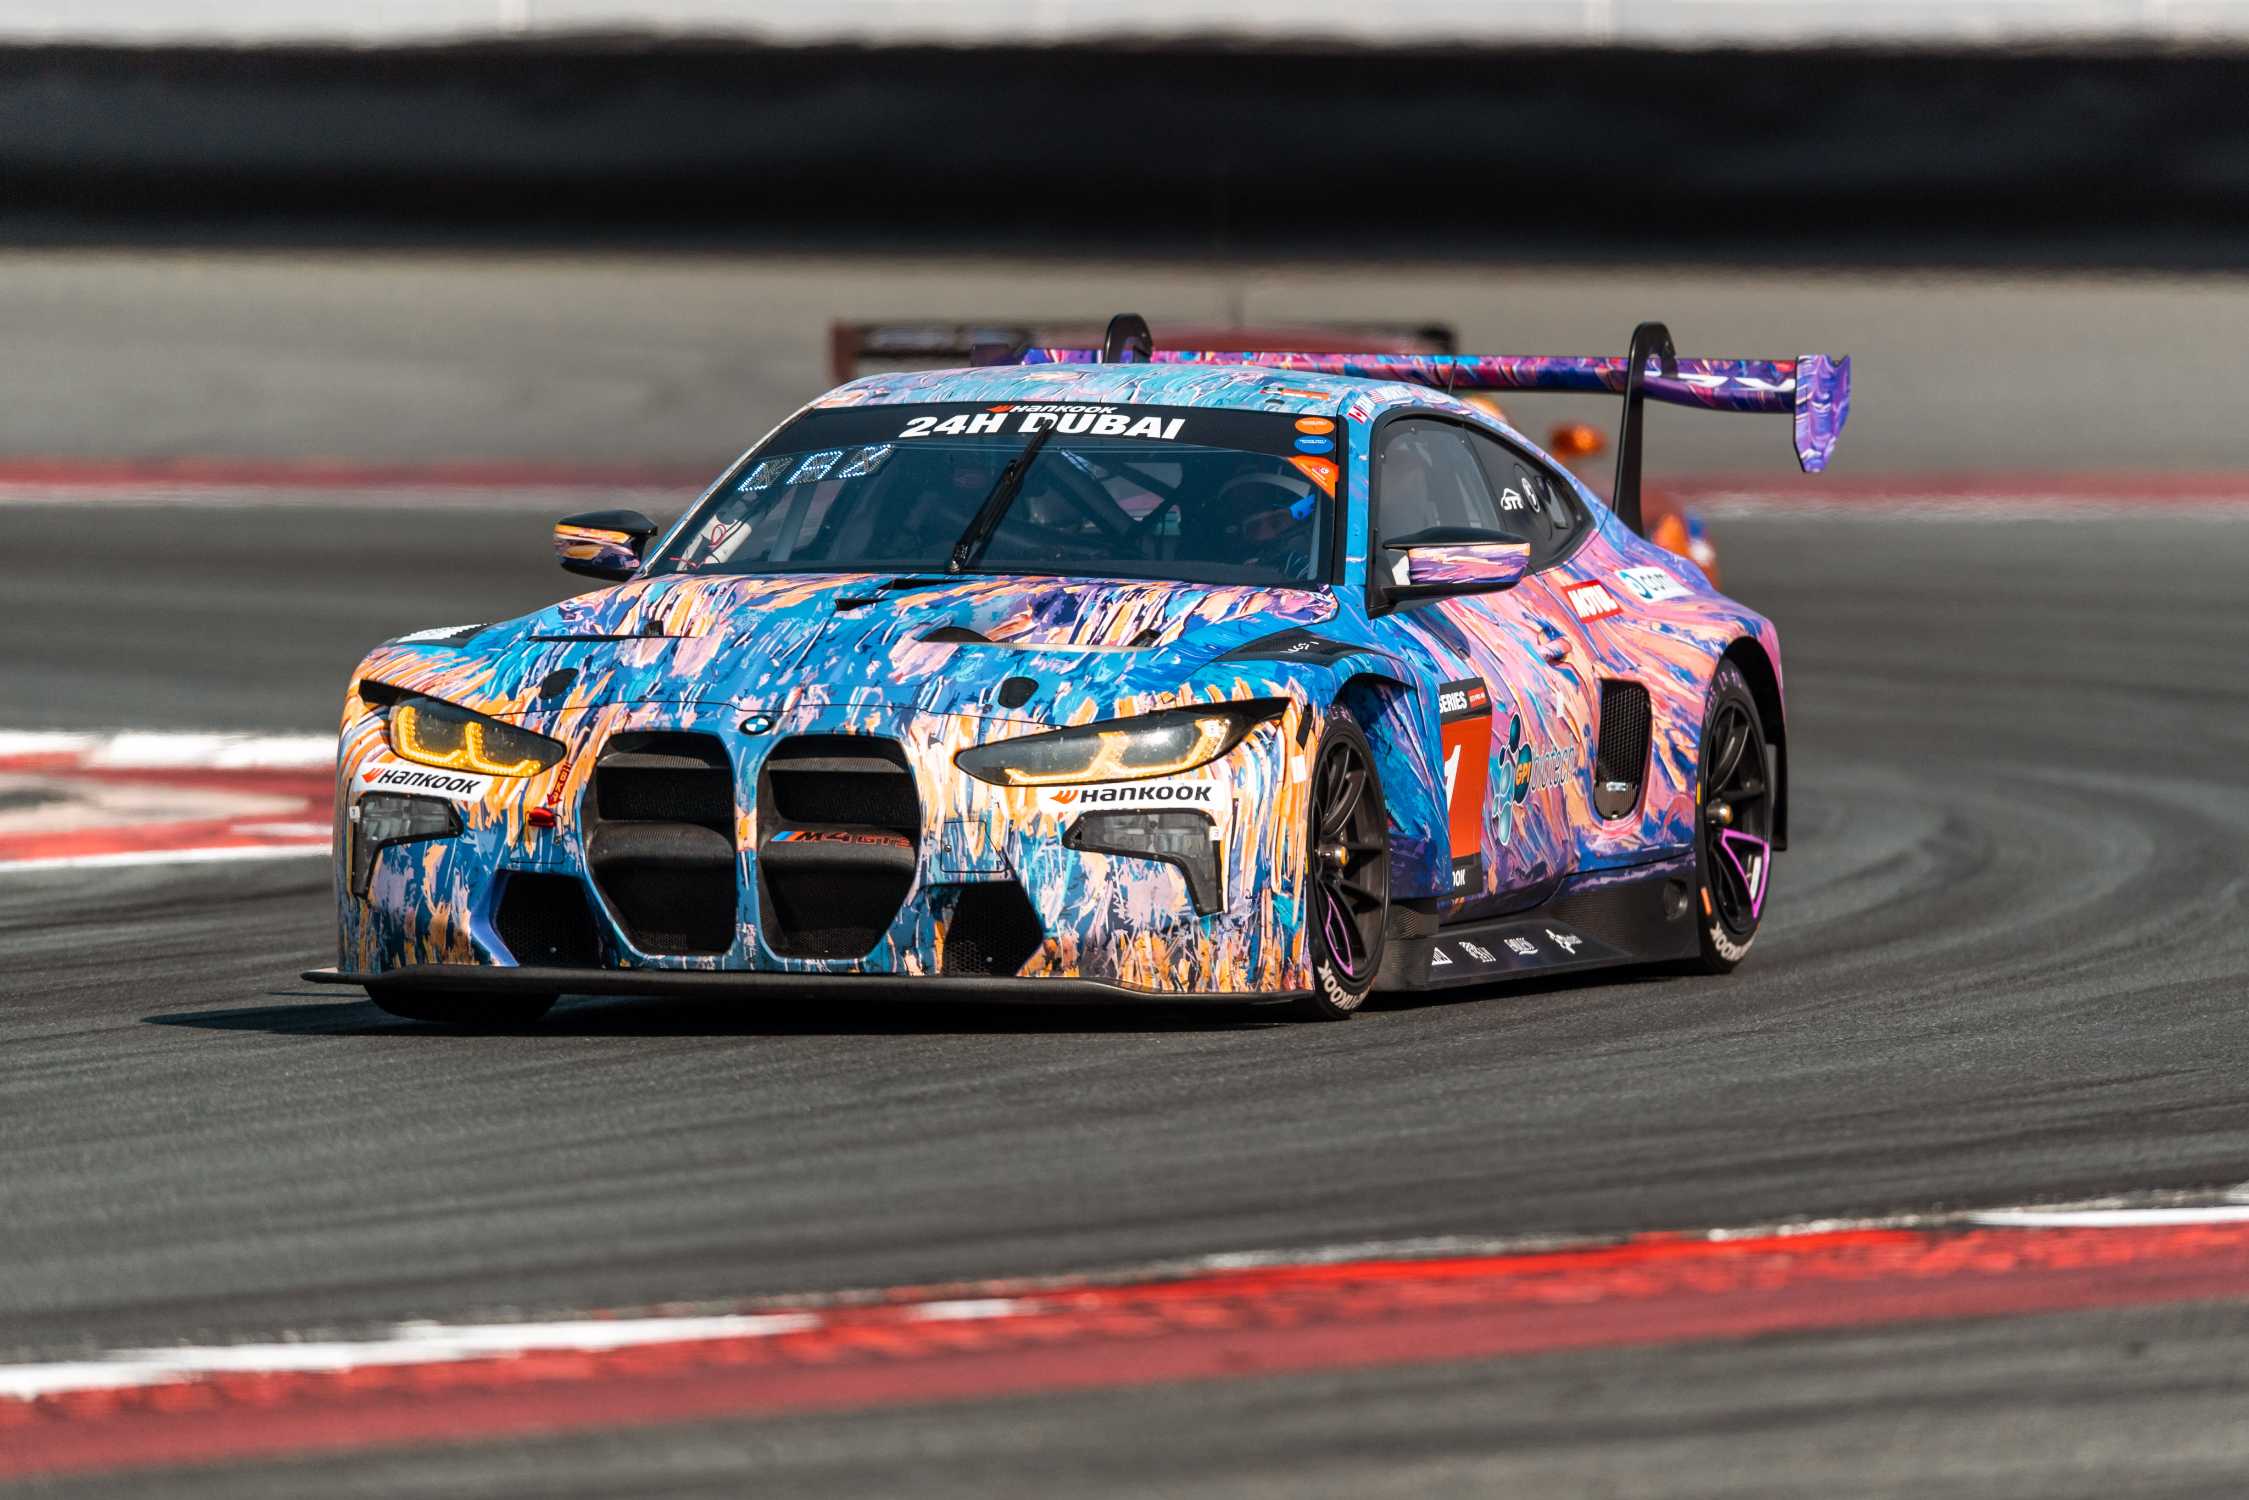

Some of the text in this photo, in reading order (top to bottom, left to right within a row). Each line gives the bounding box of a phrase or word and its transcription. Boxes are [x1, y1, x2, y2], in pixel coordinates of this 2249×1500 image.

[899, 412, 1186, 440] 24H DUBAI
[377, 769, 481, 795] HANKOOK
[1444, 744, 1462, 812] 1
[1080, 785, 1213, 803] HANKOOK
